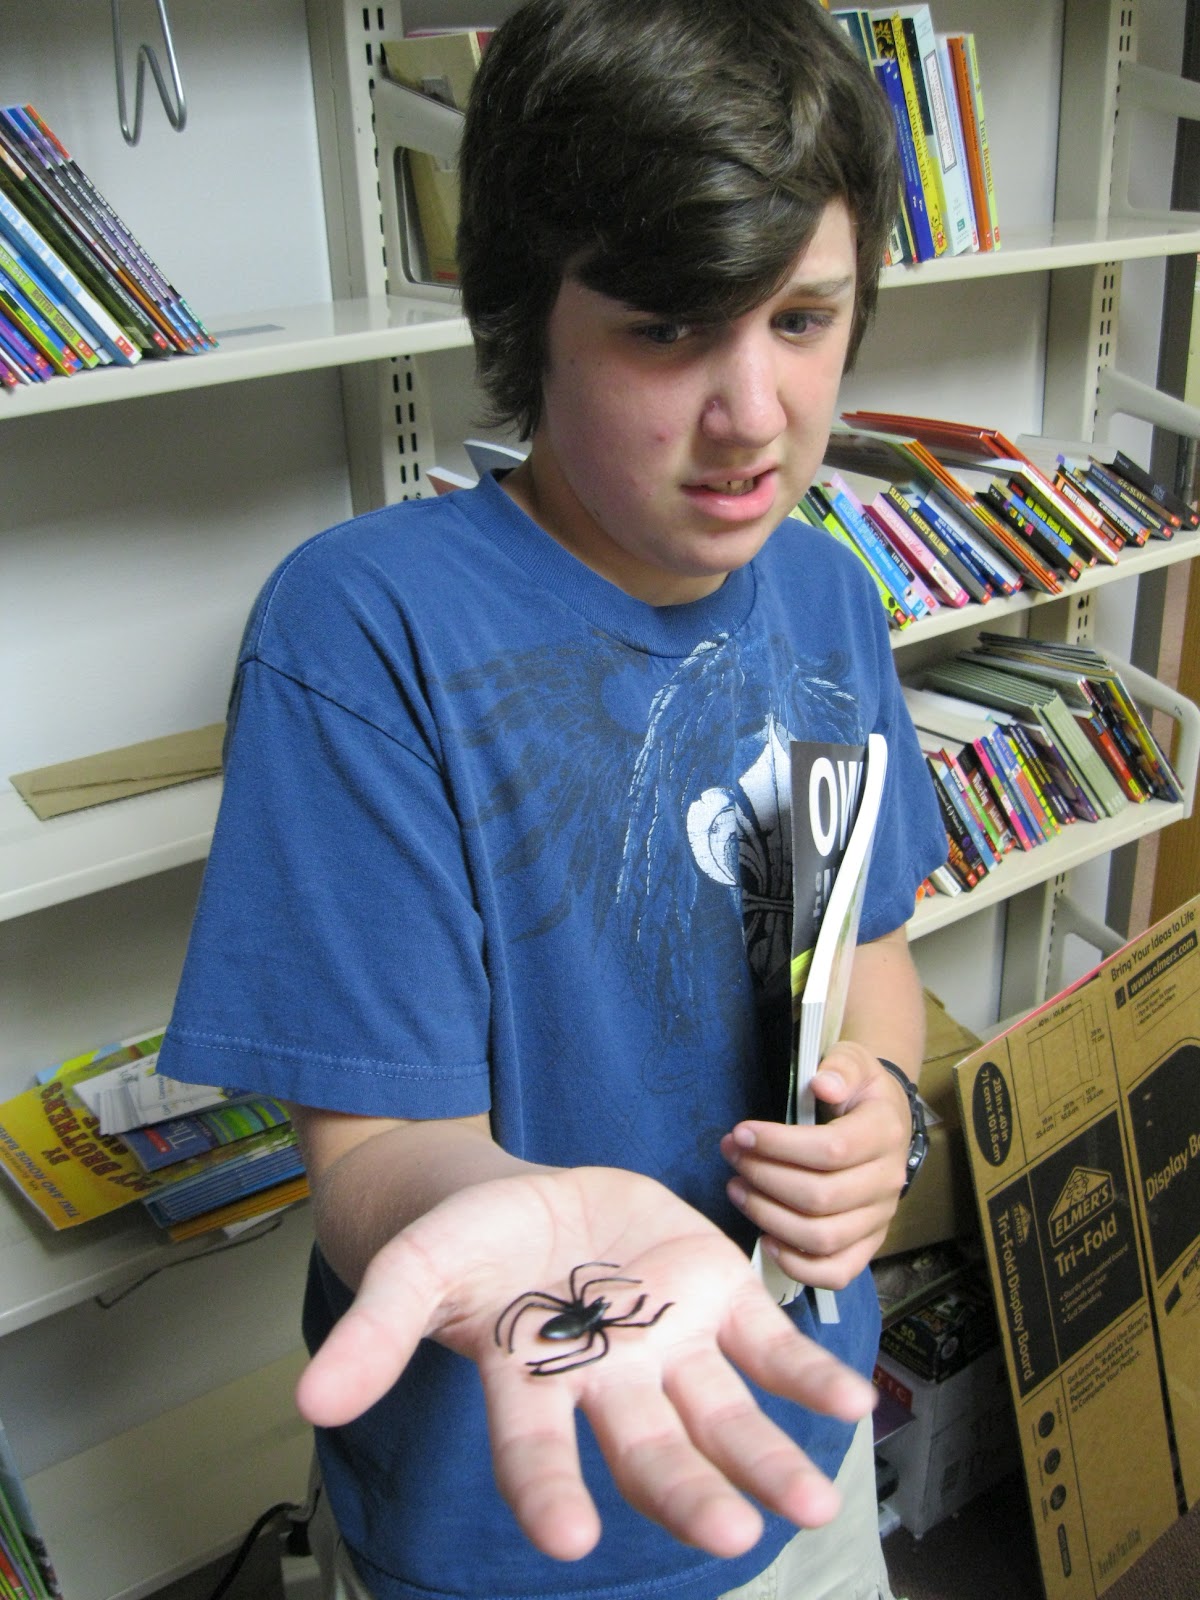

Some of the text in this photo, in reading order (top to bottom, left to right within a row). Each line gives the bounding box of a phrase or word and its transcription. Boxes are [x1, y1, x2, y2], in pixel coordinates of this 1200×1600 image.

[978, 120, 994, 194] FREE BASEBALL
[1111, 911, 1194, 982] Bring Your Ideas to Life
[1130, 937, 1194, 993] www.elmers.com
[981, 1070, 989, 1085] 71
[983, 1086, 991, 1105] cm
[993, 1077, 1002, 1094] 28
[999, 1115, 1007, 1130] 40
[1001, 1130, 1009, 1142] in
[41, 1147, 70, 1165] BY
[993, 1143, 1001, 1162] cm
[1145, 1147, 1188, 1203] Display
[1055, 1184, 1109, 1238] ELMER'S
[1054, 1212, 1118, 1277] Tri-Fold
[996, 1209, 1035, 1381] Tri-Fold Display Board
